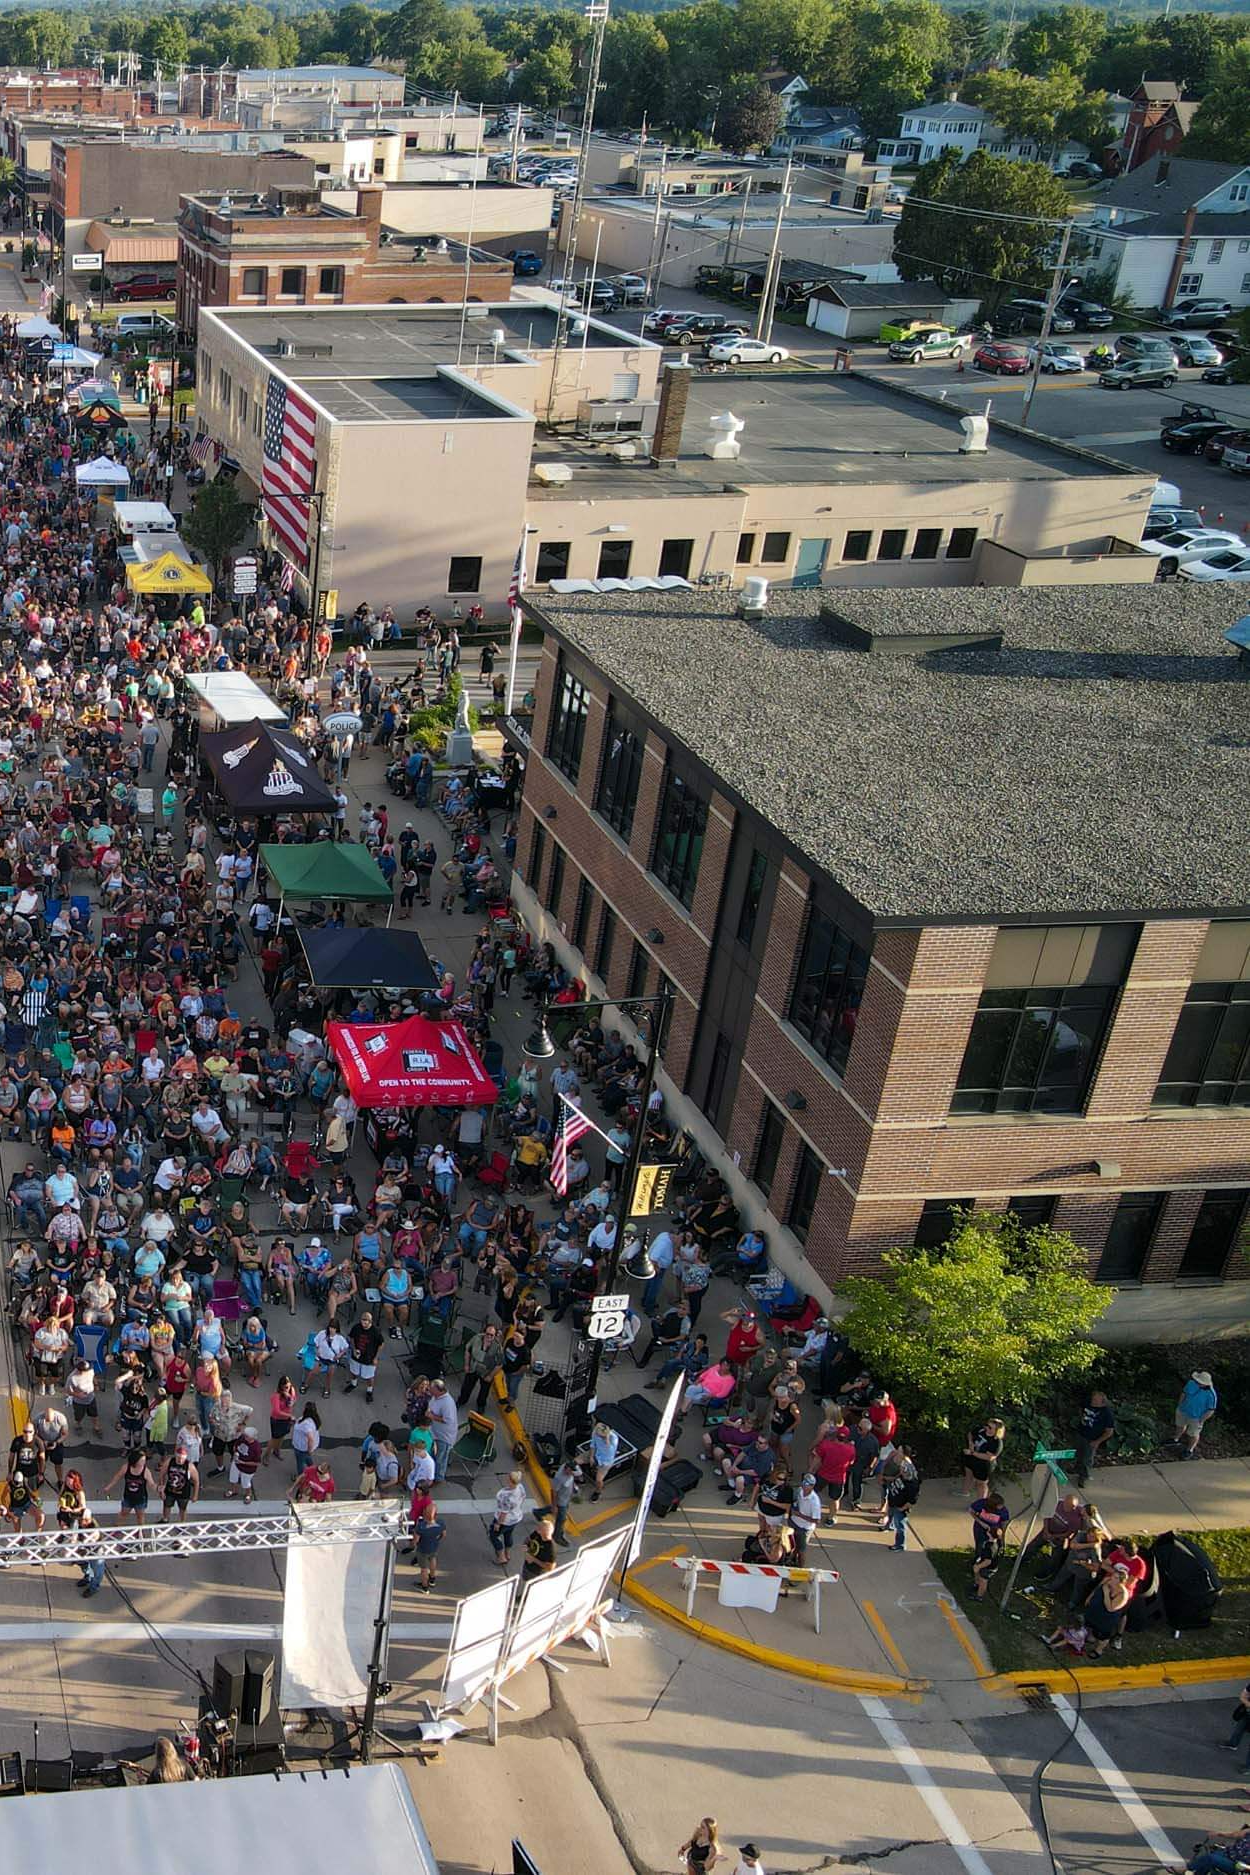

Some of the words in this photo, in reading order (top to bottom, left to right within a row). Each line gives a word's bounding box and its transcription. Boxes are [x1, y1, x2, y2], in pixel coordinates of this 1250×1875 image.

[169, 570, 178, 578] L
[330, 721, 359, 731] POLICE
[428, 1078, 472, 1086] COMMUNITY.
[654, 1170, 671, 1209] TOMAH
[598, 1299, 623, 1308] EAST
[596, 1317, 617, 1333] 12
